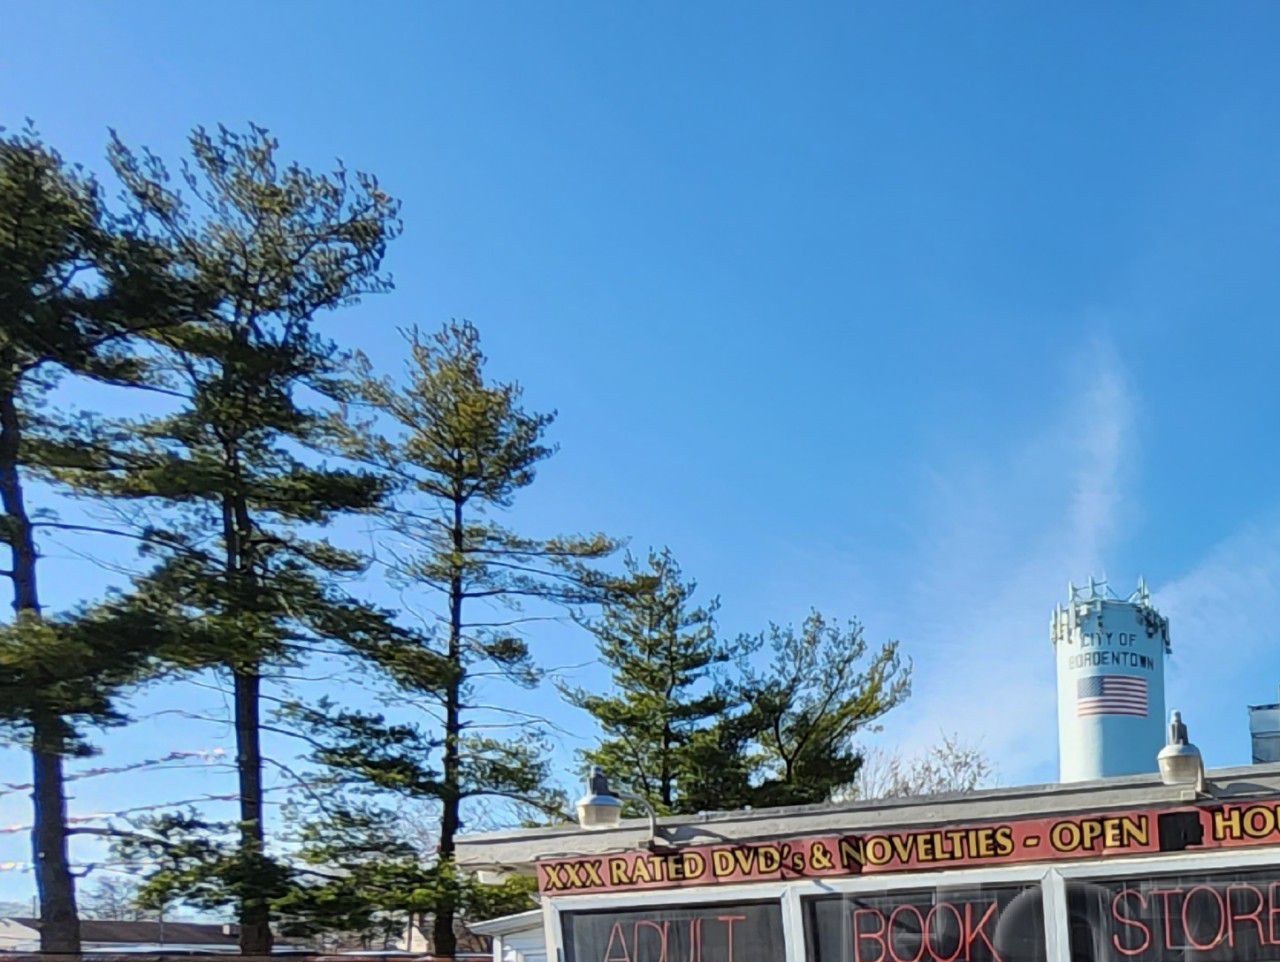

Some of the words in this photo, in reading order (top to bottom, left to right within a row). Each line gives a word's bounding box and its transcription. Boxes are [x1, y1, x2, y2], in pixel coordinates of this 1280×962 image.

[1081, 632, 1113, 647] CITY
[1118, 632, 1137, 647] OF
[1068, 651, 1154, 670] BORDENTOWN
[545, 862, 603, 891] XXX
[609, 851, 706, 885] RATED
[809, 841, 834, 869] &
[839, 825, 1015, 868] NOVELTIES
[1049, 814, 1150, 852] OPEN
